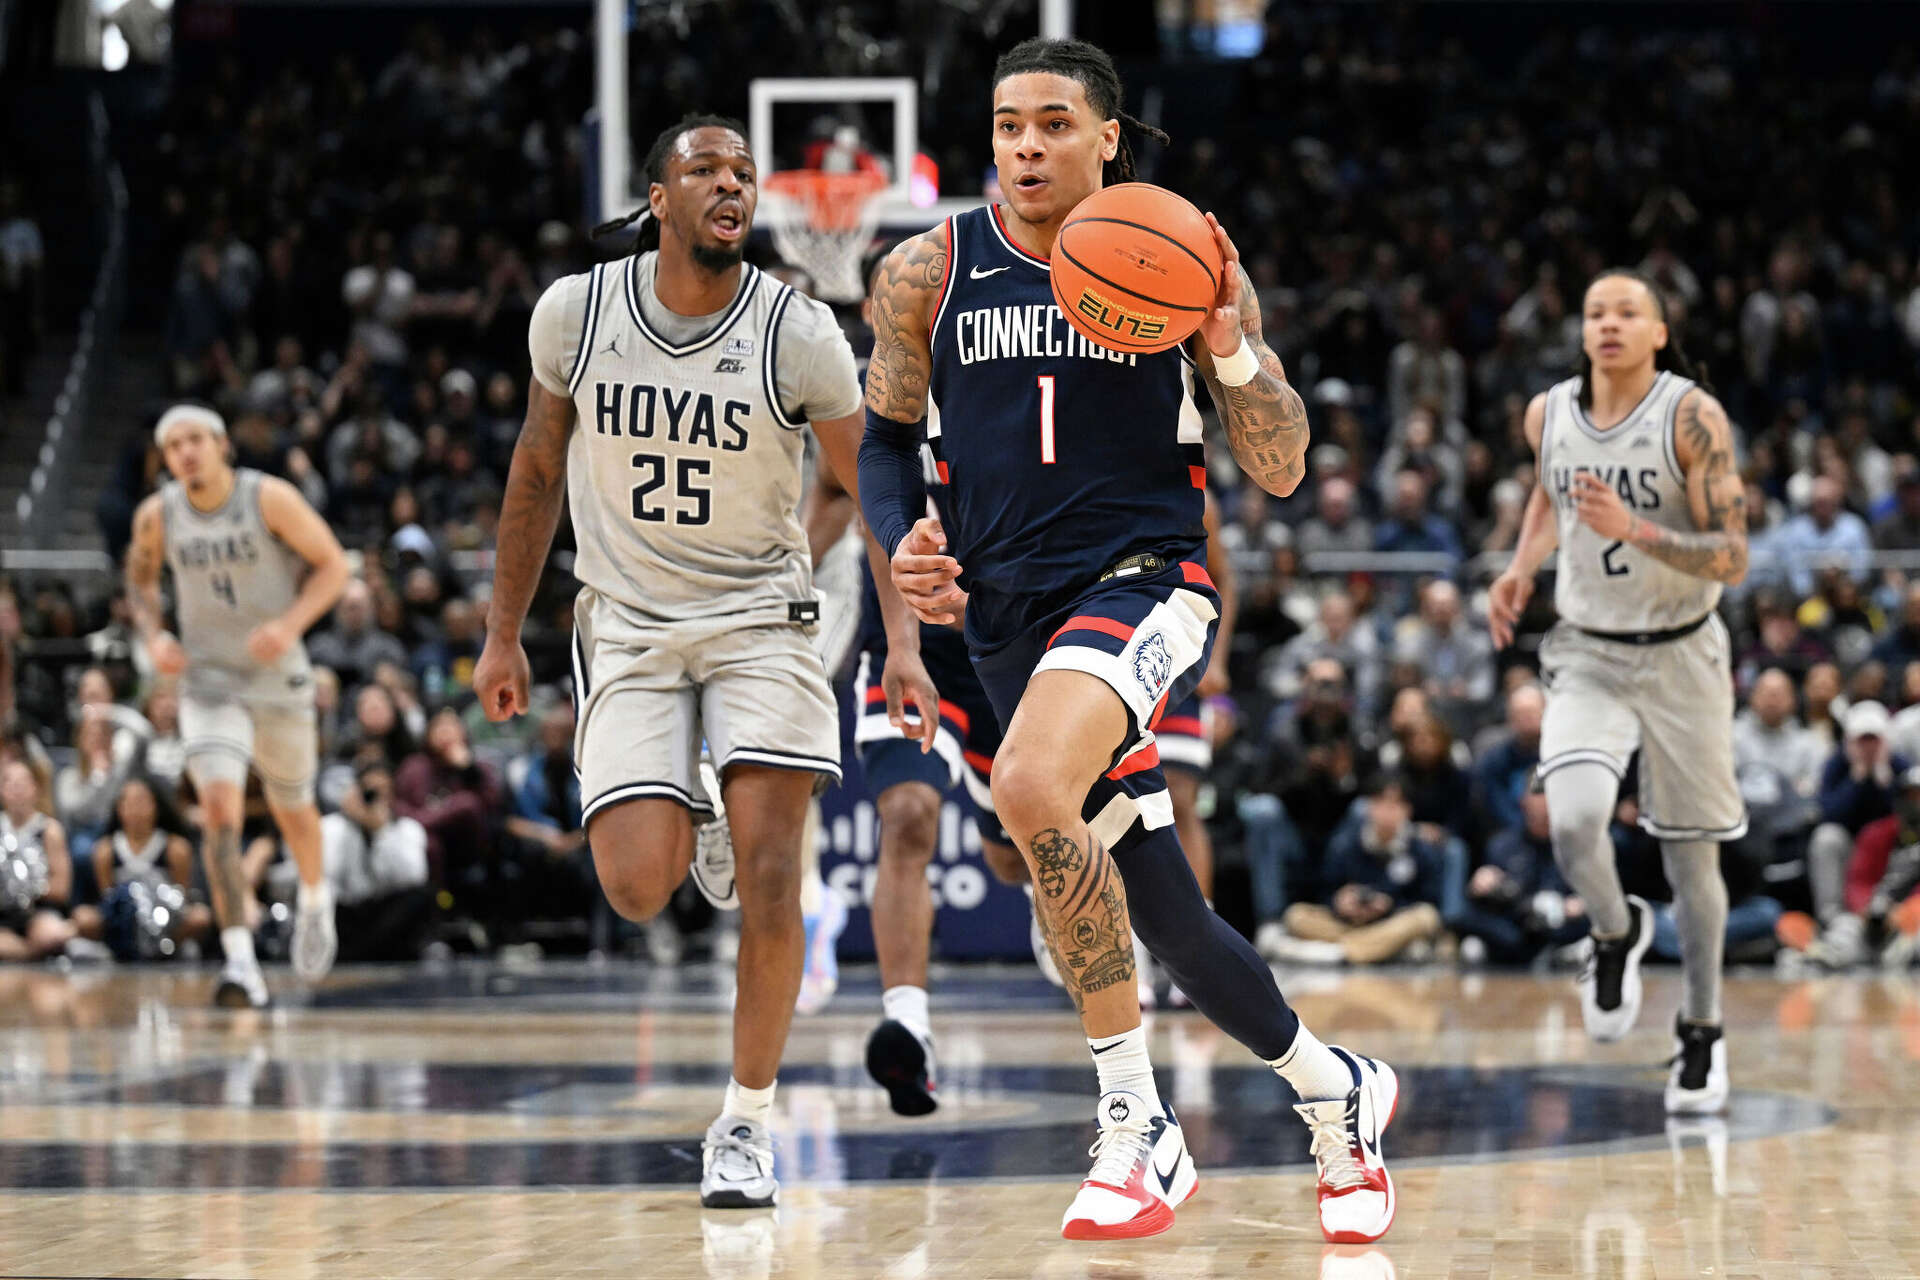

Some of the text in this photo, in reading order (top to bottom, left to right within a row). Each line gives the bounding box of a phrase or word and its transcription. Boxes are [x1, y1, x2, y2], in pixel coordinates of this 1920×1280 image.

[956, 304, 1137, 367] CONNEC
[1078, 292, 1167, 339] ELITE
[595, 382, 751, 452] HOYAS
[1037, 375, 1056, 464] 1
[631, 452, 712, 526] 25
[210, 572, 237, 607] 4
